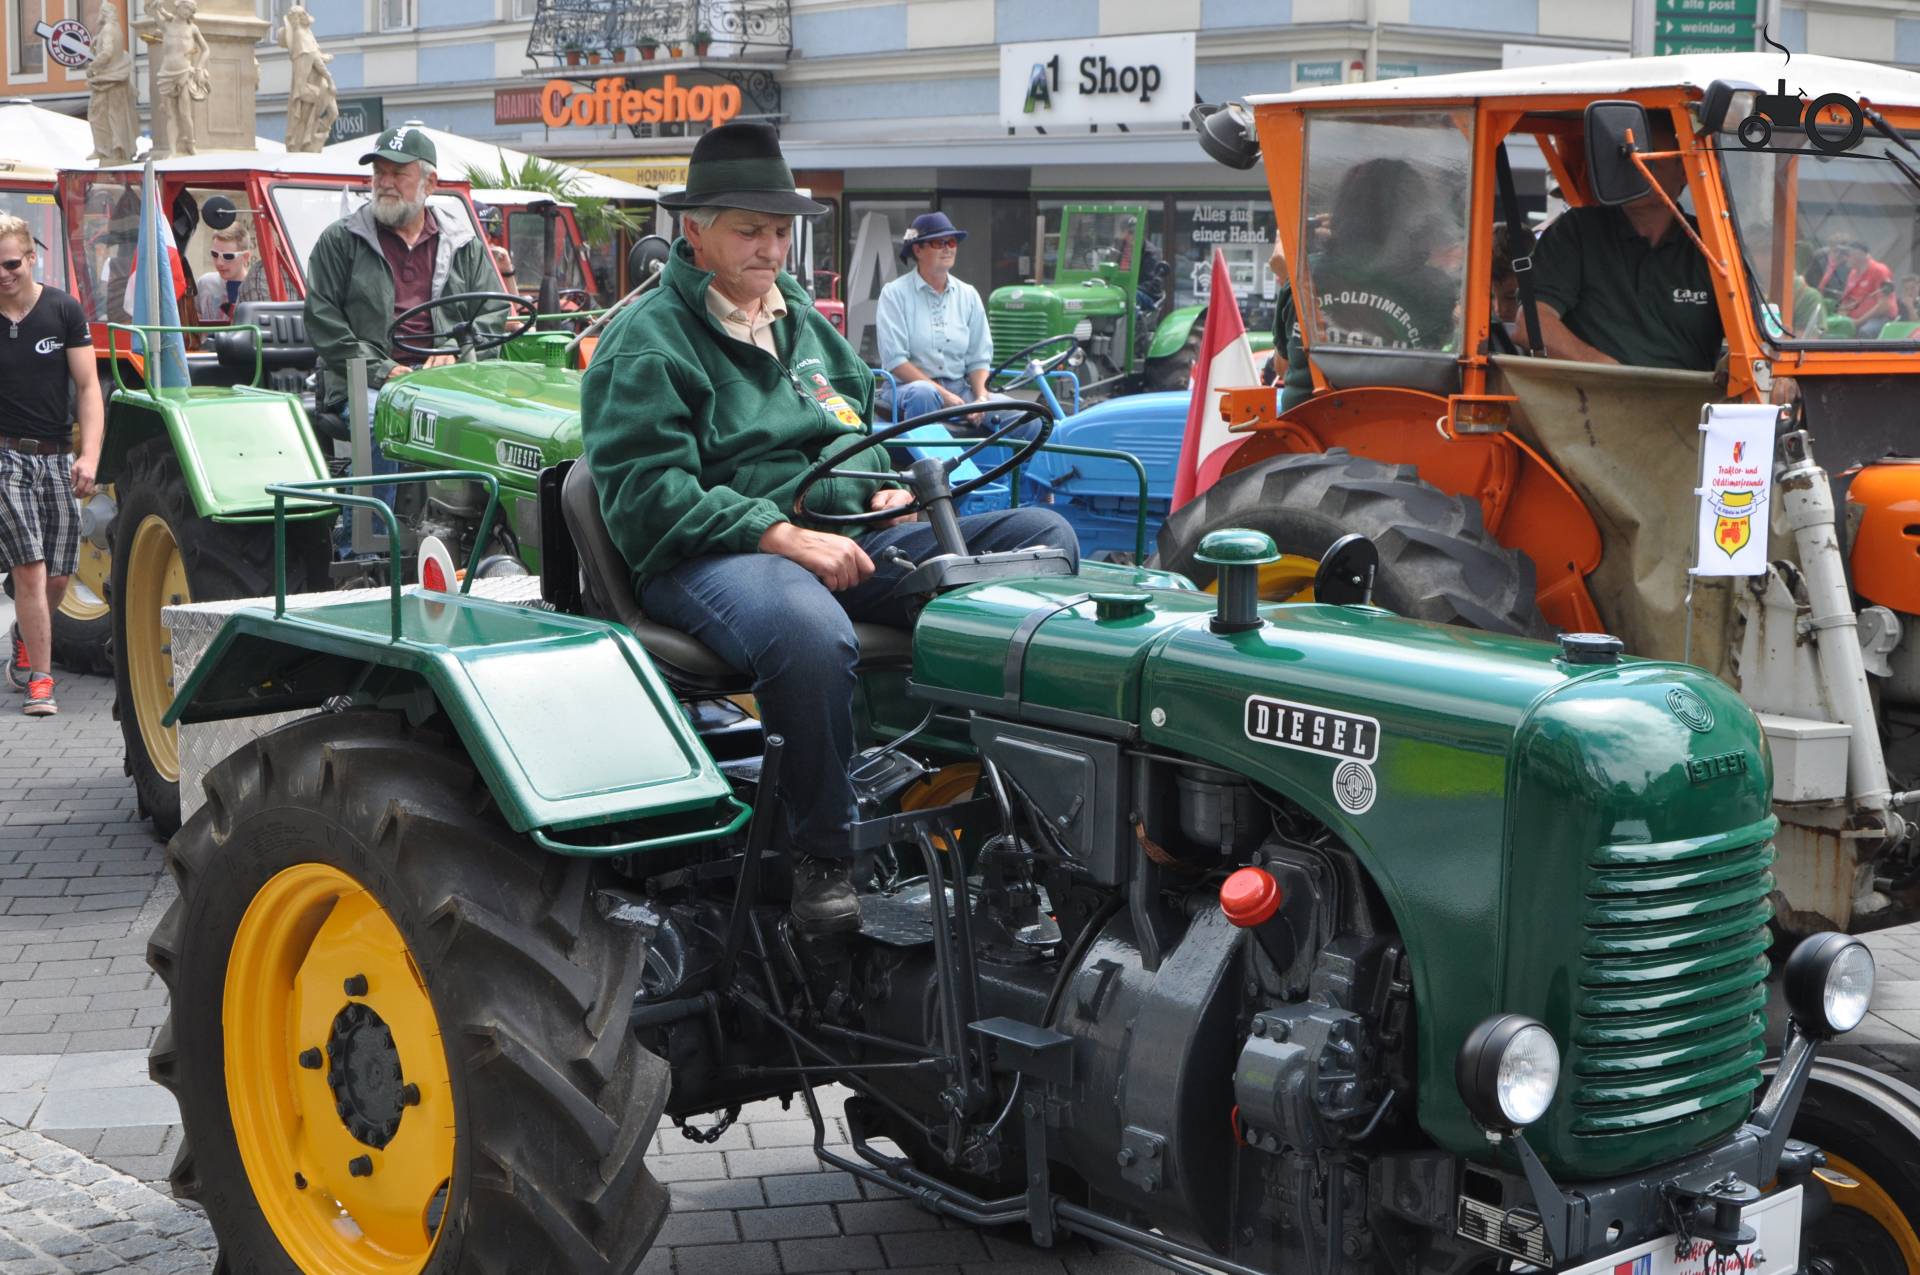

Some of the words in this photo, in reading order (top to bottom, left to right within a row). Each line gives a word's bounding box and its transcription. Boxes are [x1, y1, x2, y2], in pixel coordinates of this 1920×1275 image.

[1682, 0, 1704, 10] alte
[1708, 0, 1735, 12] post
[58, 23, 89, 40] TABAK
[1681, 21, 1735, 34] weinland
[52, 40, 82, 63] TRAFIK
[1023, 54, 1060, 113] A1
[1079, 56, 1161, 102] Shop
[496, 91, 561, 120] ADANITSH
[637, 169, 676, 182] HORNIG
[1192, 205, 1226, 221] Alles
[1230, 209, 1254, 221] aus
[1192, 226, 1226, 241] einer
[1230, 226, 1269, 242] Hand.
[508, 445, 538, 469] DIESEL
[1718, 465, 1744, 476] Traktor-
[1745, 466, 1758, 474] und
[1712, 478, 1764, 488] Oldtimerfreunde
[1256, 704, 1366, 755] DIESEL
